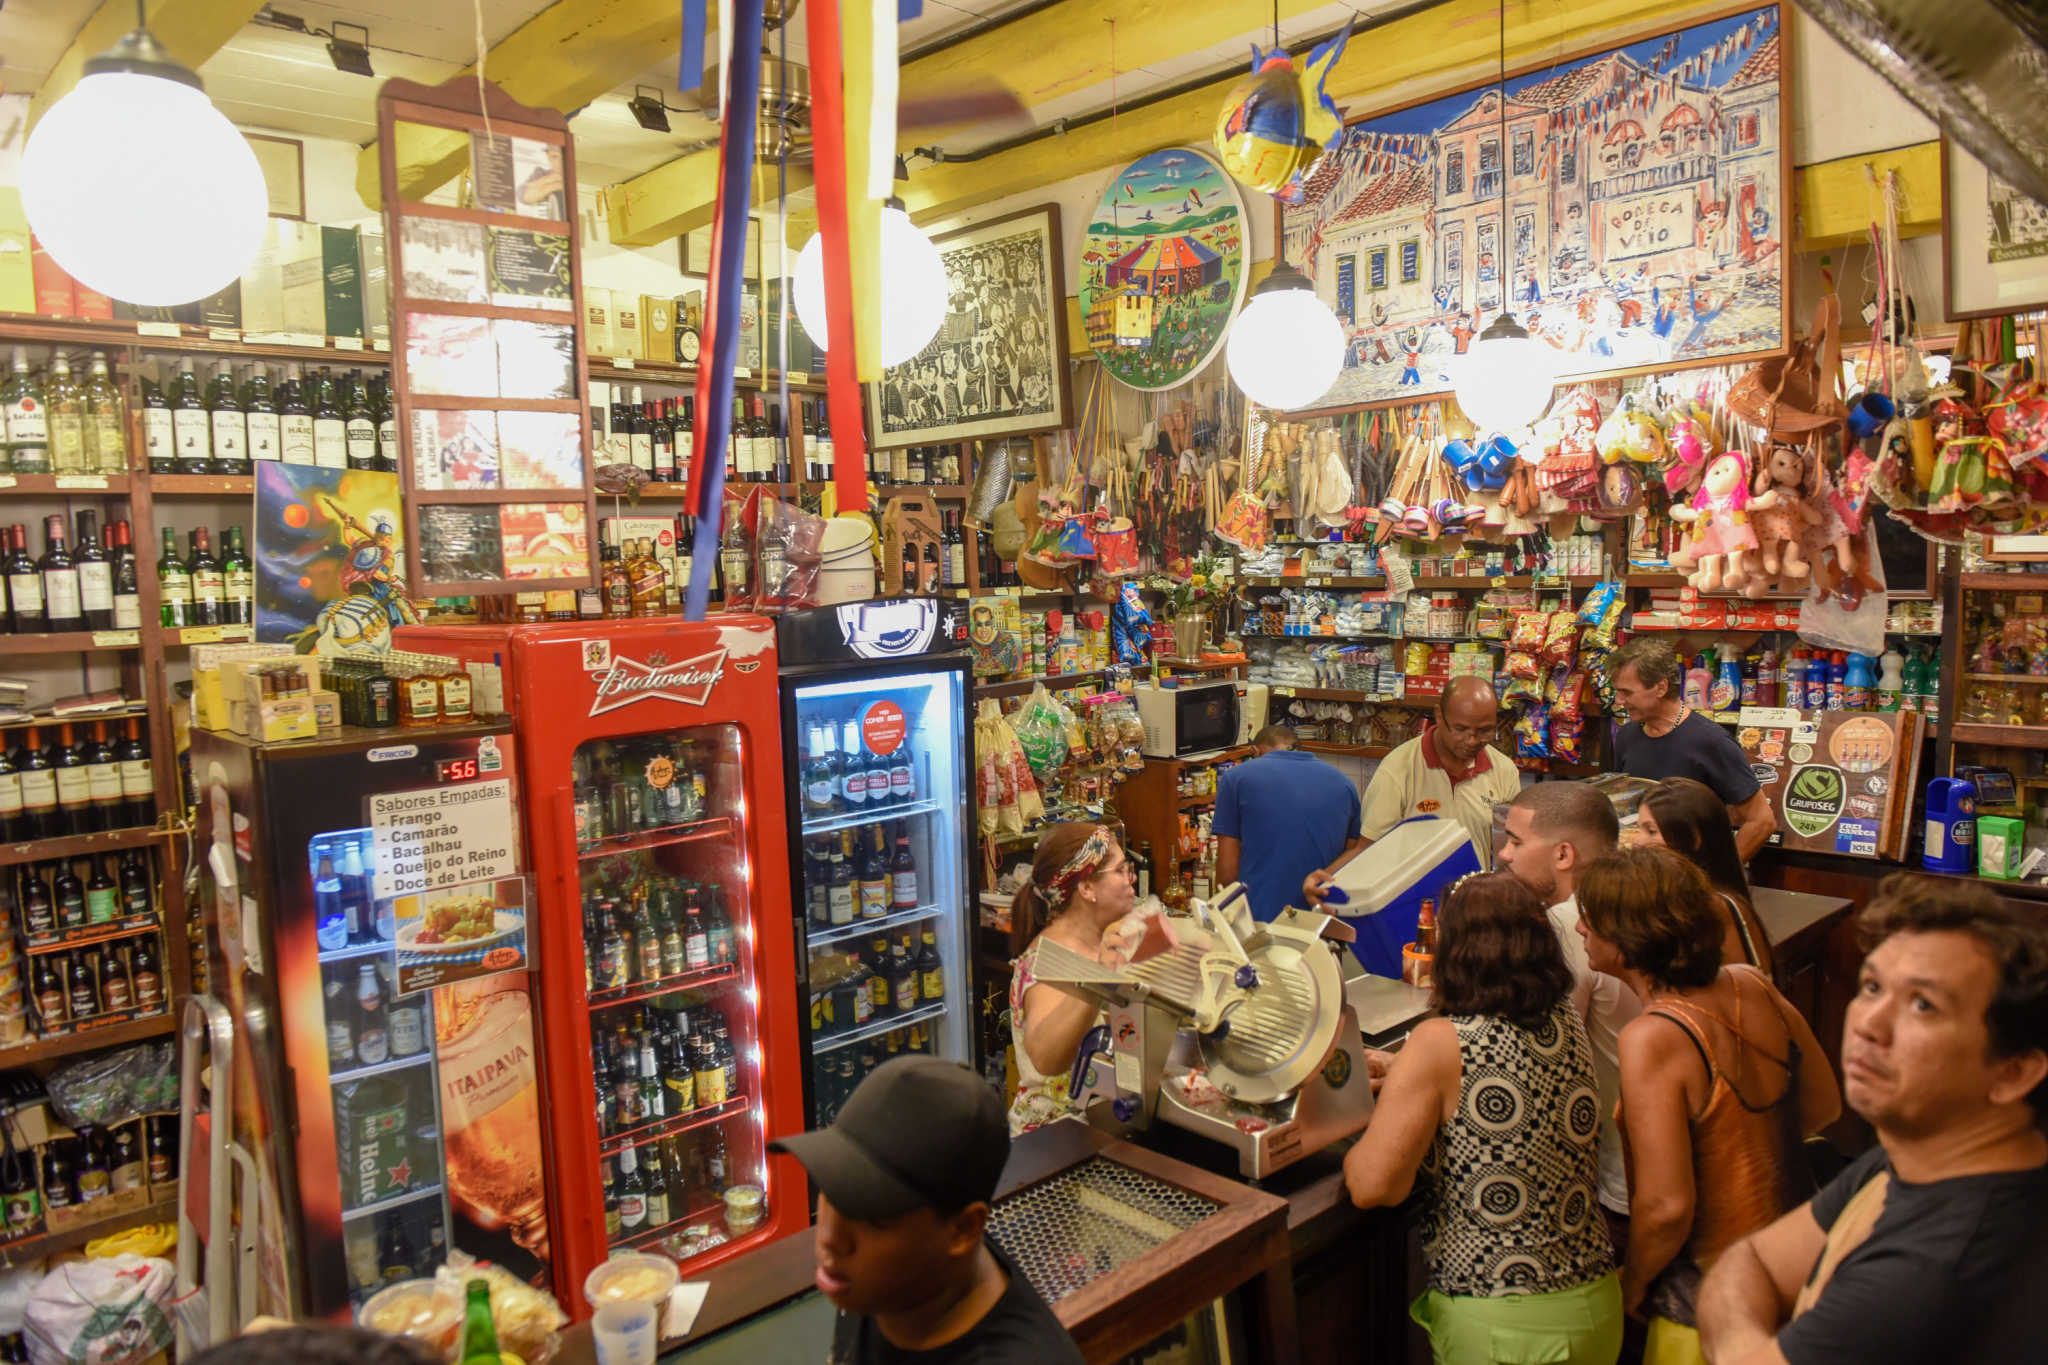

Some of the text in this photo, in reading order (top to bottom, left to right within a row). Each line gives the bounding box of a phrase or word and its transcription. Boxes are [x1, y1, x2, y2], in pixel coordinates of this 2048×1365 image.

[591, 667, 724, 695] Budweiser
[376, 785, 506, 813] Sabores Empadas:
[1790, 798, 1836, 812] GRUPOSEG
[390, 811, 442, 828] Frango
[391, 824, 458, 843] Camarão
[392, 840, 462, 859] Bacalhau
[393, 858, 442, 876] Queijo
[447, 855, 464, 867] do
[468, 848, 507, 863] Reino
[395, 877, 433, 892] Doce
[438, 872, 455, 884] de
[461, 865, 495, 881] Leite
[447, 1045, 529, 1099] ITAIPAVA
